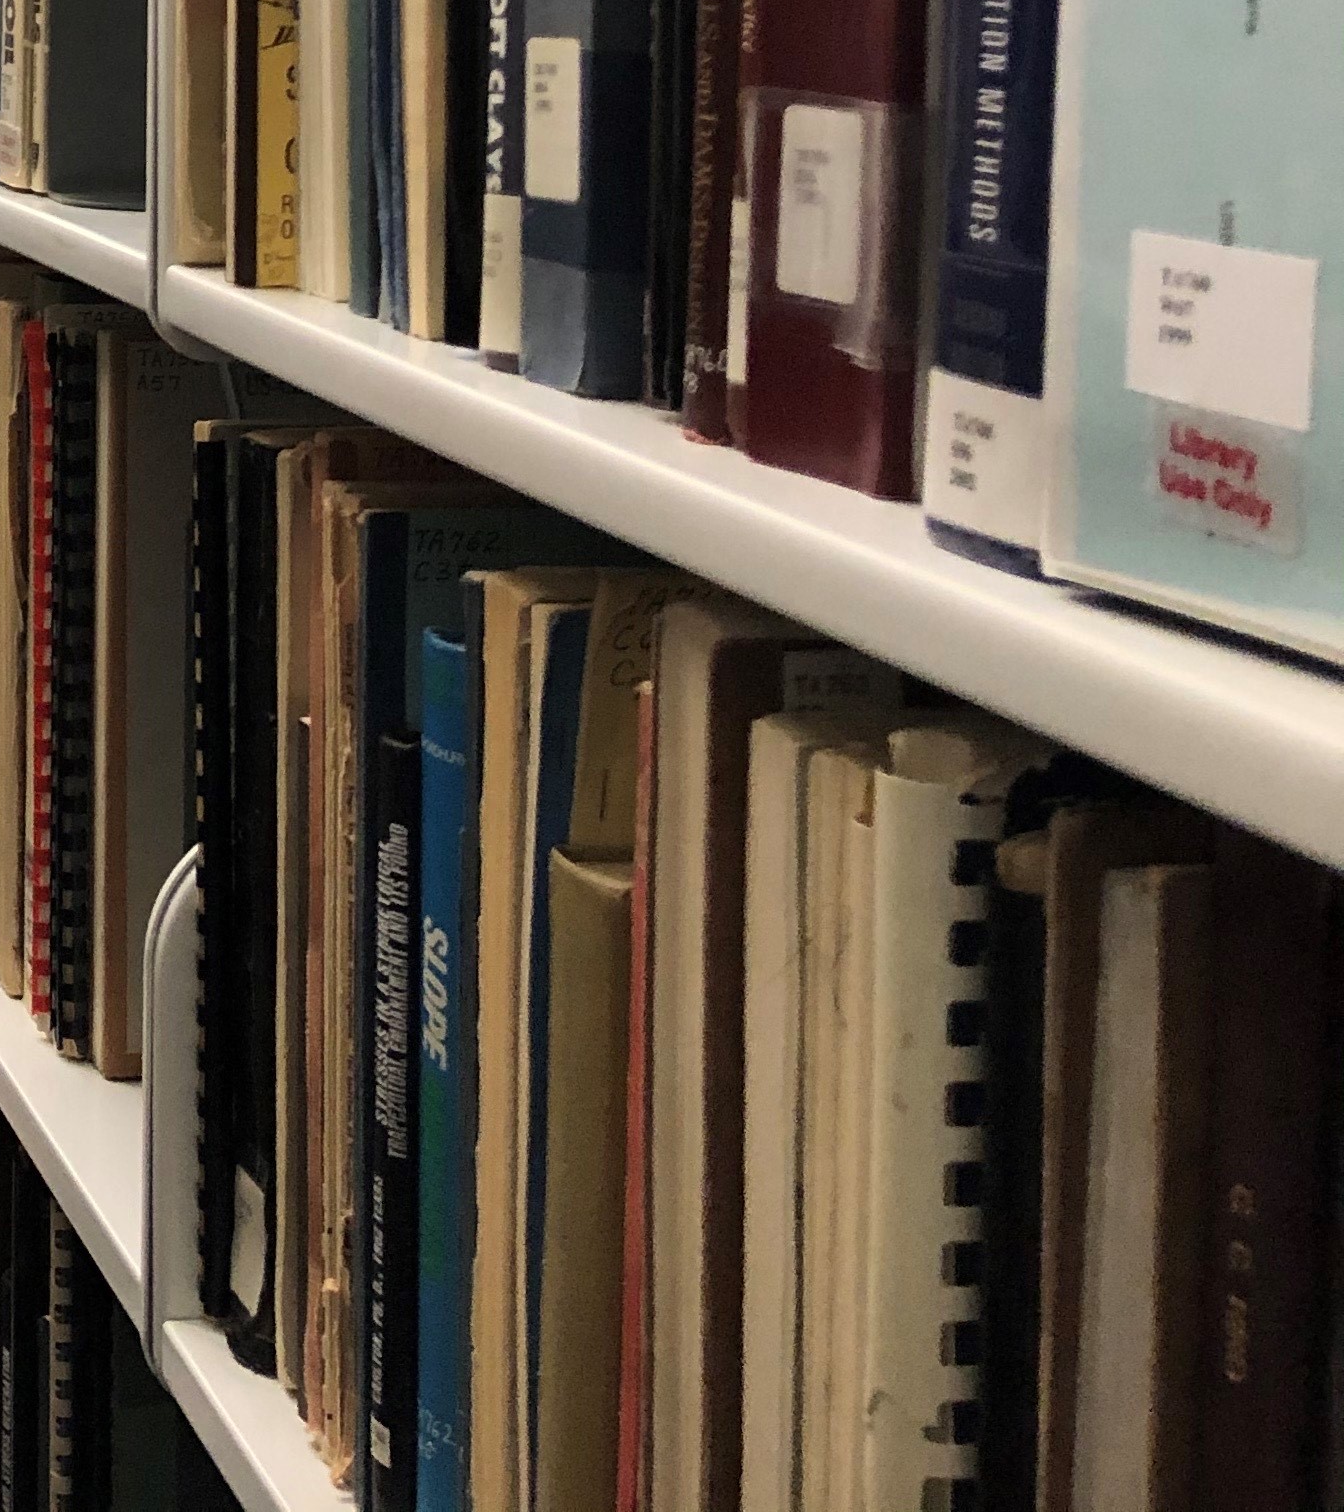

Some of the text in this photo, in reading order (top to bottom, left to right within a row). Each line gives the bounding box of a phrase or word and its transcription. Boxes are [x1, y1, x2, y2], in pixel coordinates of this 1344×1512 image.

[484, 68, 507, 192] CLAYS
[967, 87, 1006, 242] METHODS
[1157, 455, 1273, 531] Use Only
[1168, 420, 1257, 482] Library
[389, 909, 410, 943] AND
[390, 880, 410, 905] ITS
[388, 947, 410, 1053] EMBANKMENT
[421, 916, 449, 1071] SLOPE
[387, 1058, 408, 1159] TRAPEZOIDAL
